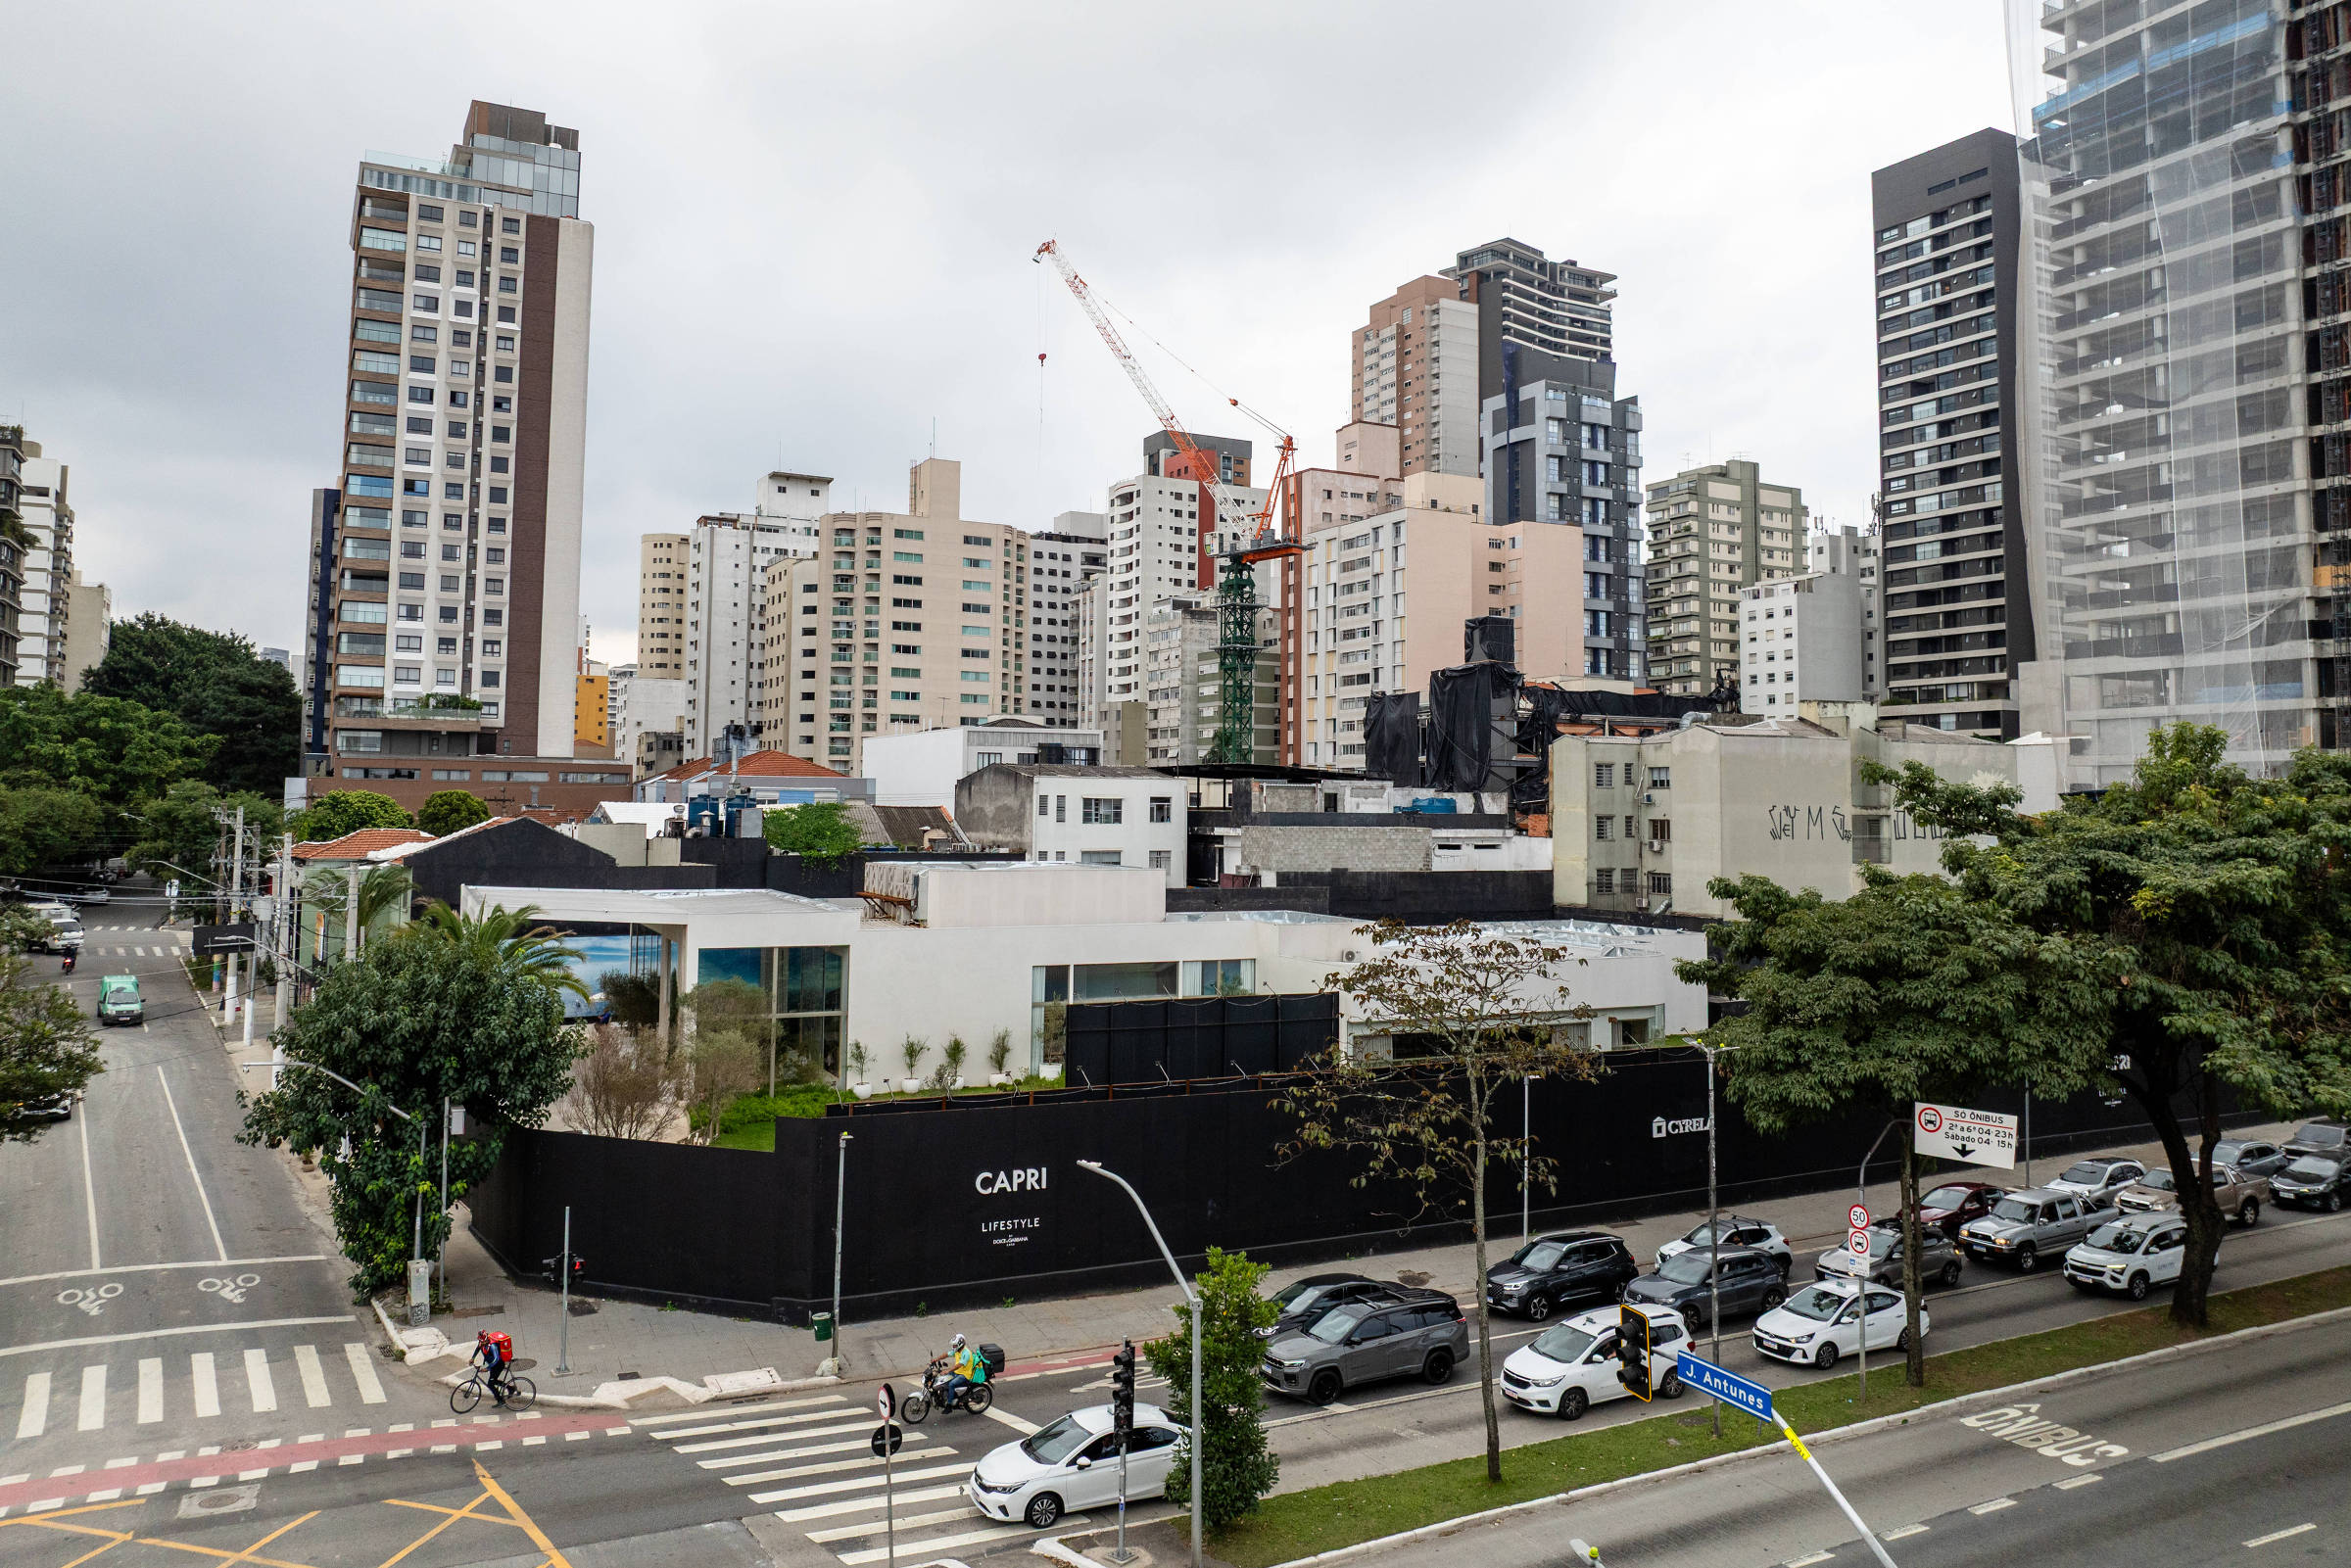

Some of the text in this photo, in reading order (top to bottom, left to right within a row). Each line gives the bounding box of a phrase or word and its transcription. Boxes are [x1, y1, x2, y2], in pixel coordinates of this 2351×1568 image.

[1953, 1110, 2004, 1124] SÓ ÔNIBUS
[975, 1166, 1047, 1195] CAPRI
[982, 1217, 1040, 1232] LIFESTYLE
[1852, 1211, 1866, 1222] 50
[1685, 1363, 1764, 1410] J. Antunes
[1958, 1402, 2130, 1466] ÔNIBUS
